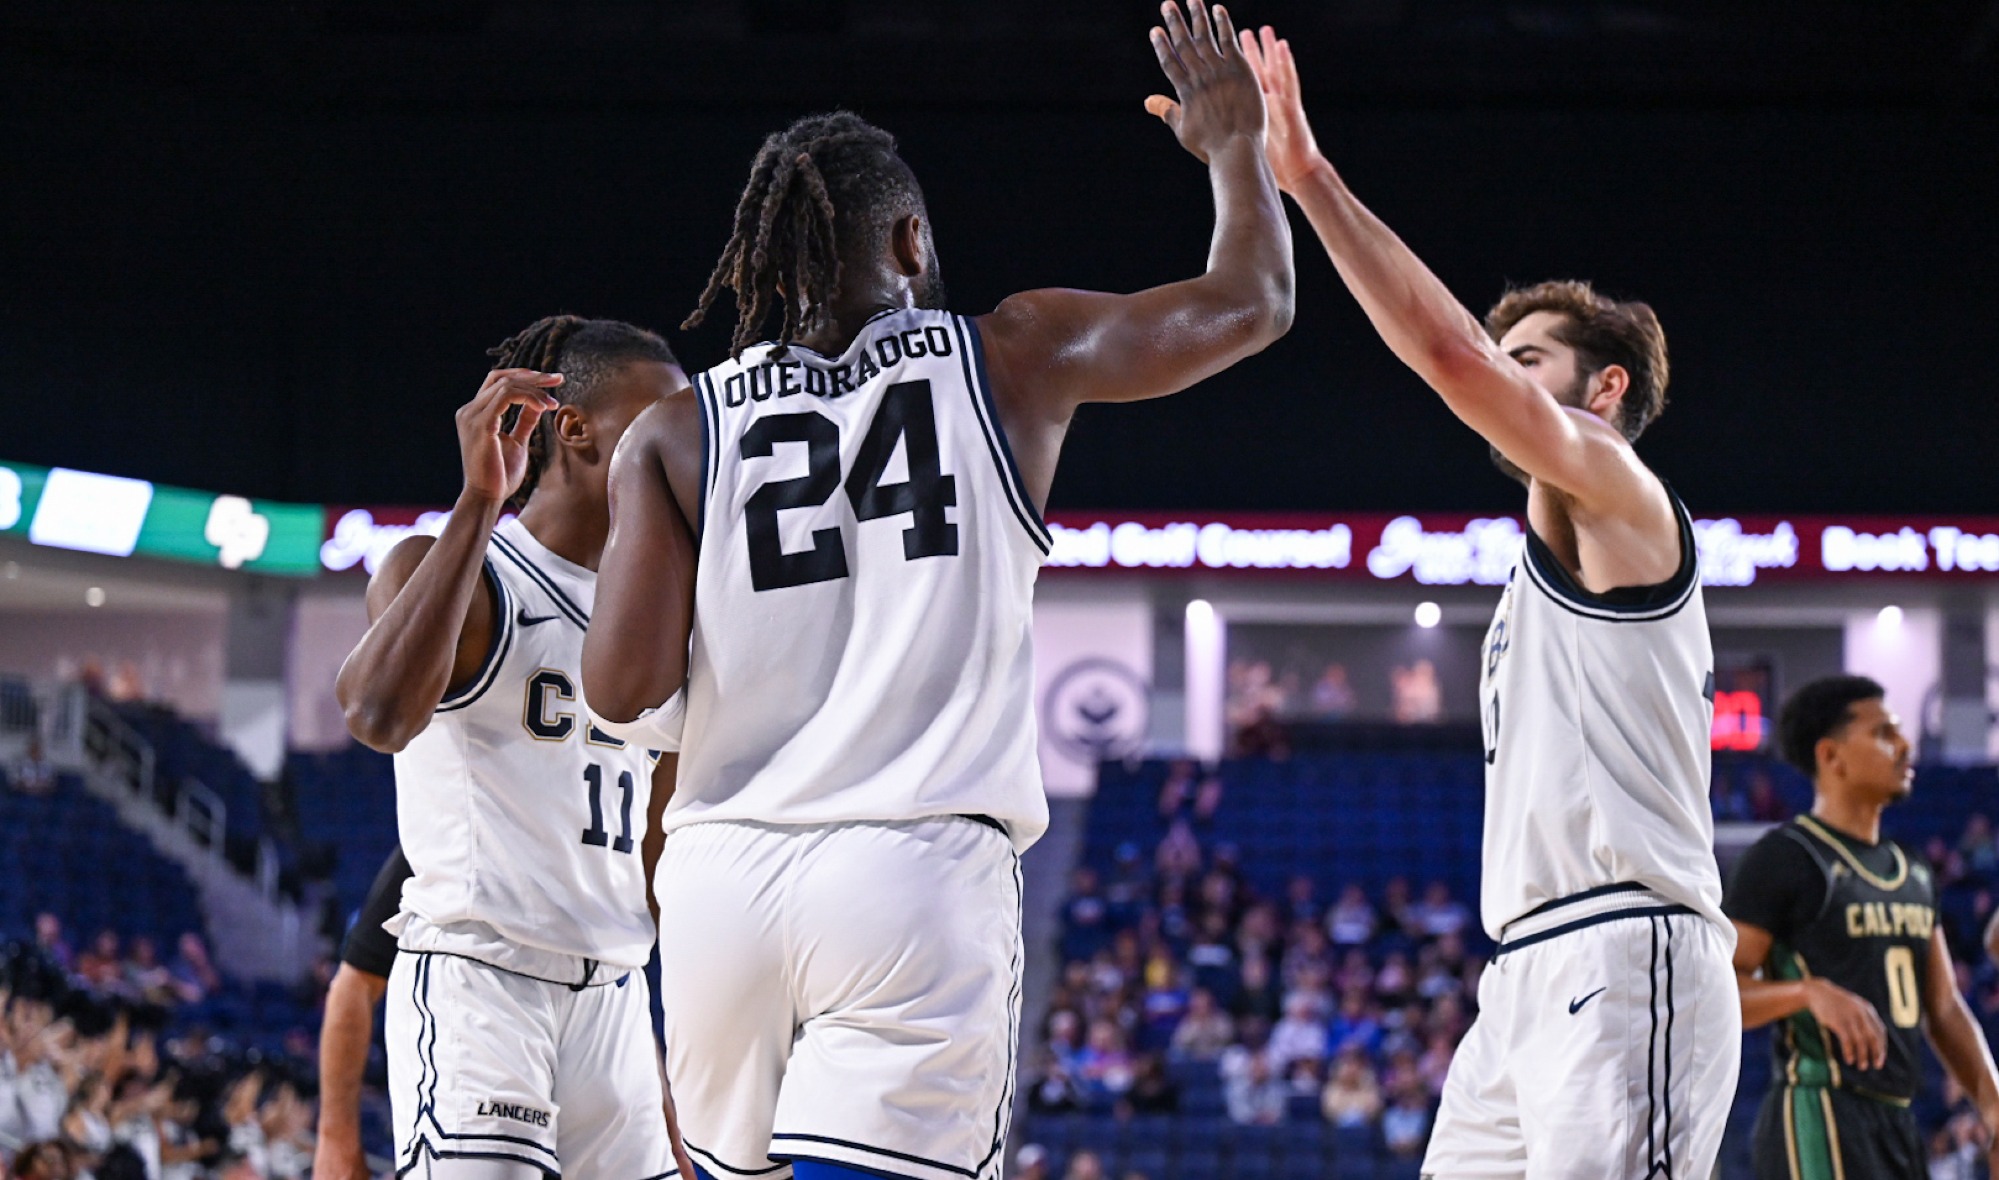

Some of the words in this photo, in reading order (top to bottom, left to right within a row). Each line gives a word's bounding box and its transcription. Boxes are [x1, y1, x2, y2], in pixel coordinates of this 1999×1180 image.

[724, 325, 953, 409] OUEDRAOGO
[739, 377, 959, 593] 24
[581, 761, 635, 855] 11
[1884, 945, 1920, 1029] 0
[476, 1100, 552, 1128] LANCERS
